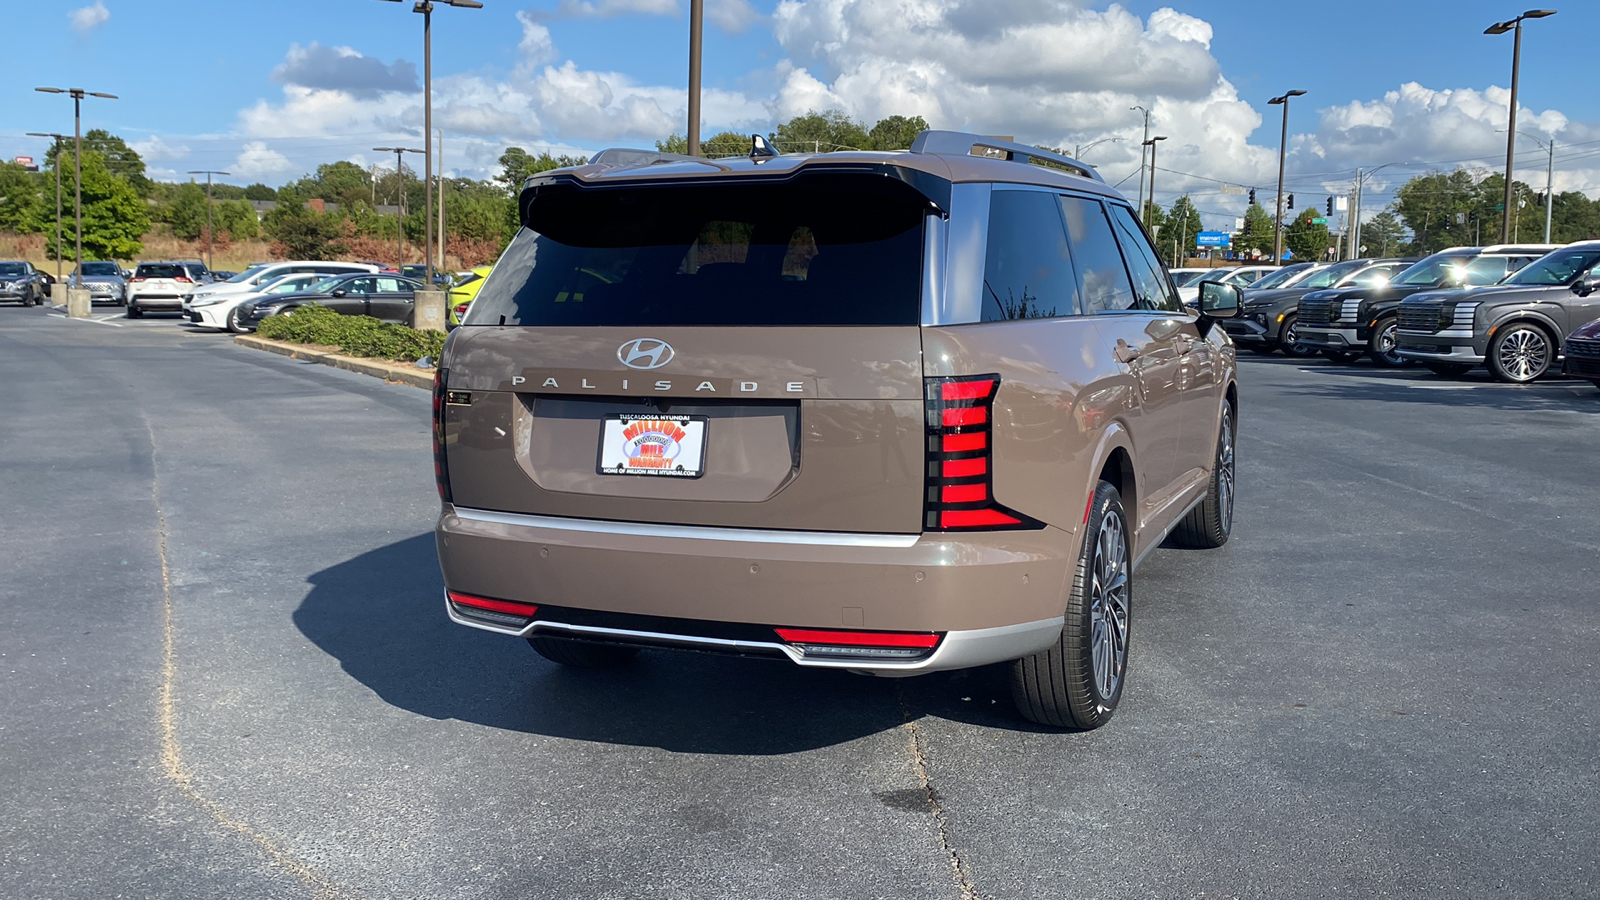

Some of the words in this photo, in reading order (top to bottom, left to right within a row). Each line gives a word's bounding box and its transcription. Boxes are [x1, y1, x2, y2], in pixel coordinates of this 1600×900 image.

[511, 376, 804, 393] PALISADE
[622, 419, 687, 444] MILLION
[640, 444, 664, 458] MILE
[628, 457, 674, 469] WARRANTY
